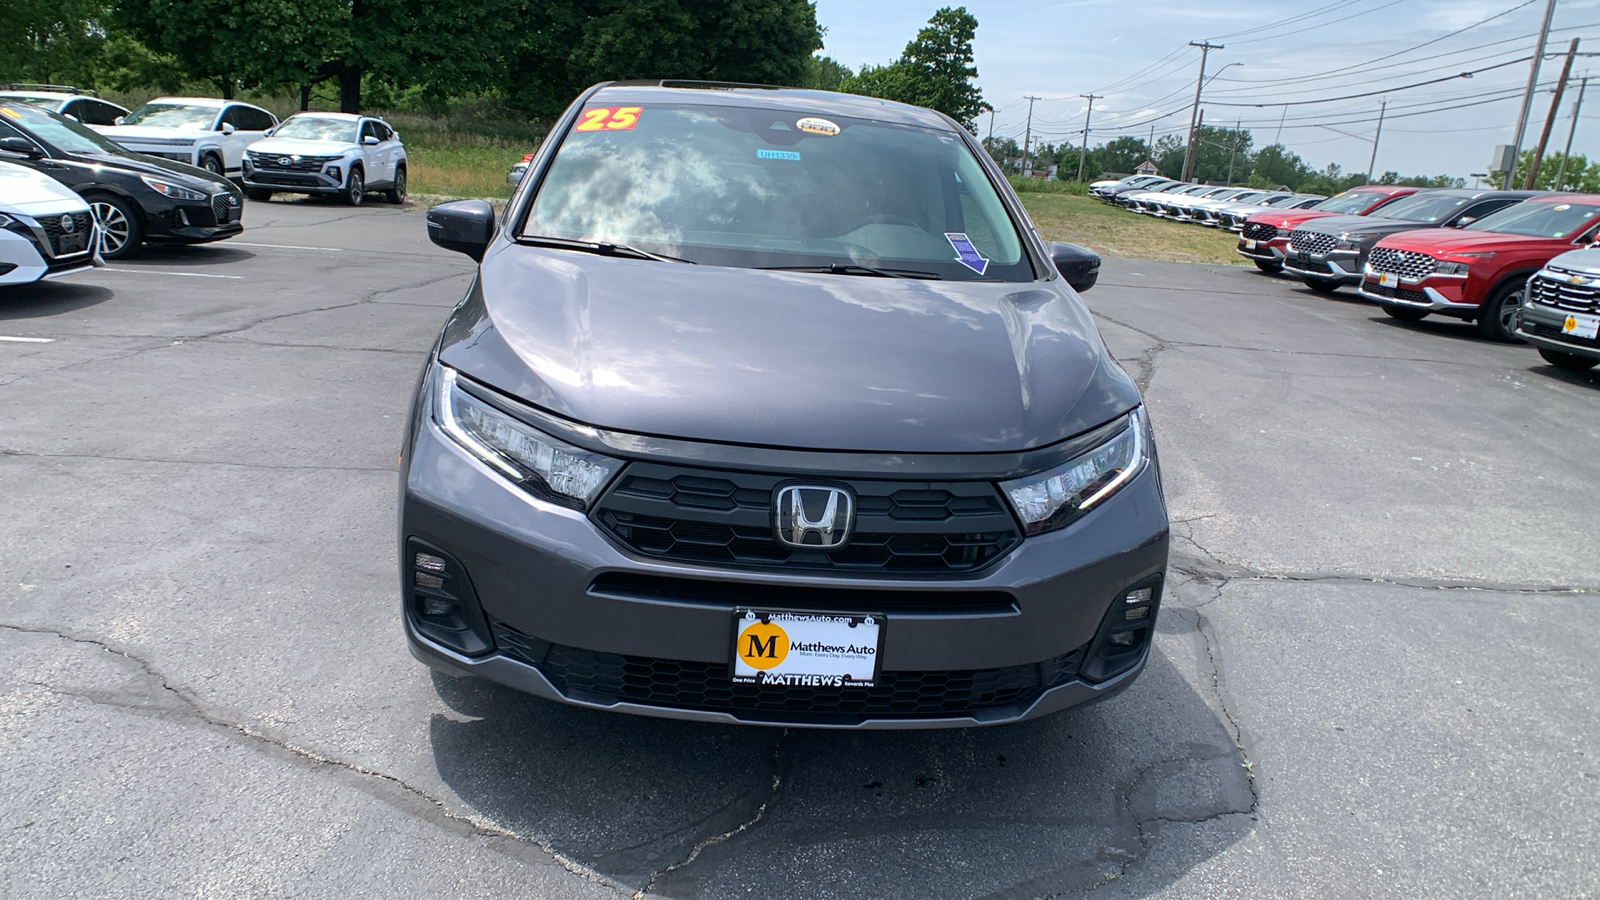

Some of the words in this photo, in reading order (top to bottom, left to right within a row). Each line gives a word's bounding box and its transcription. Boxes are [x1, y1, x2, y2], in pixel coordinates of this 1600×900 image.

[577, 107, 641, 131] 25
[768, 612, 853, 624] MatthewsAuto.com
[744, 634, 780, 659] M
[790, 641, 845, 653] Matthews
[846, 644, 876, 655] Auto
[761, 674, 843, 687] MATTHEWS
